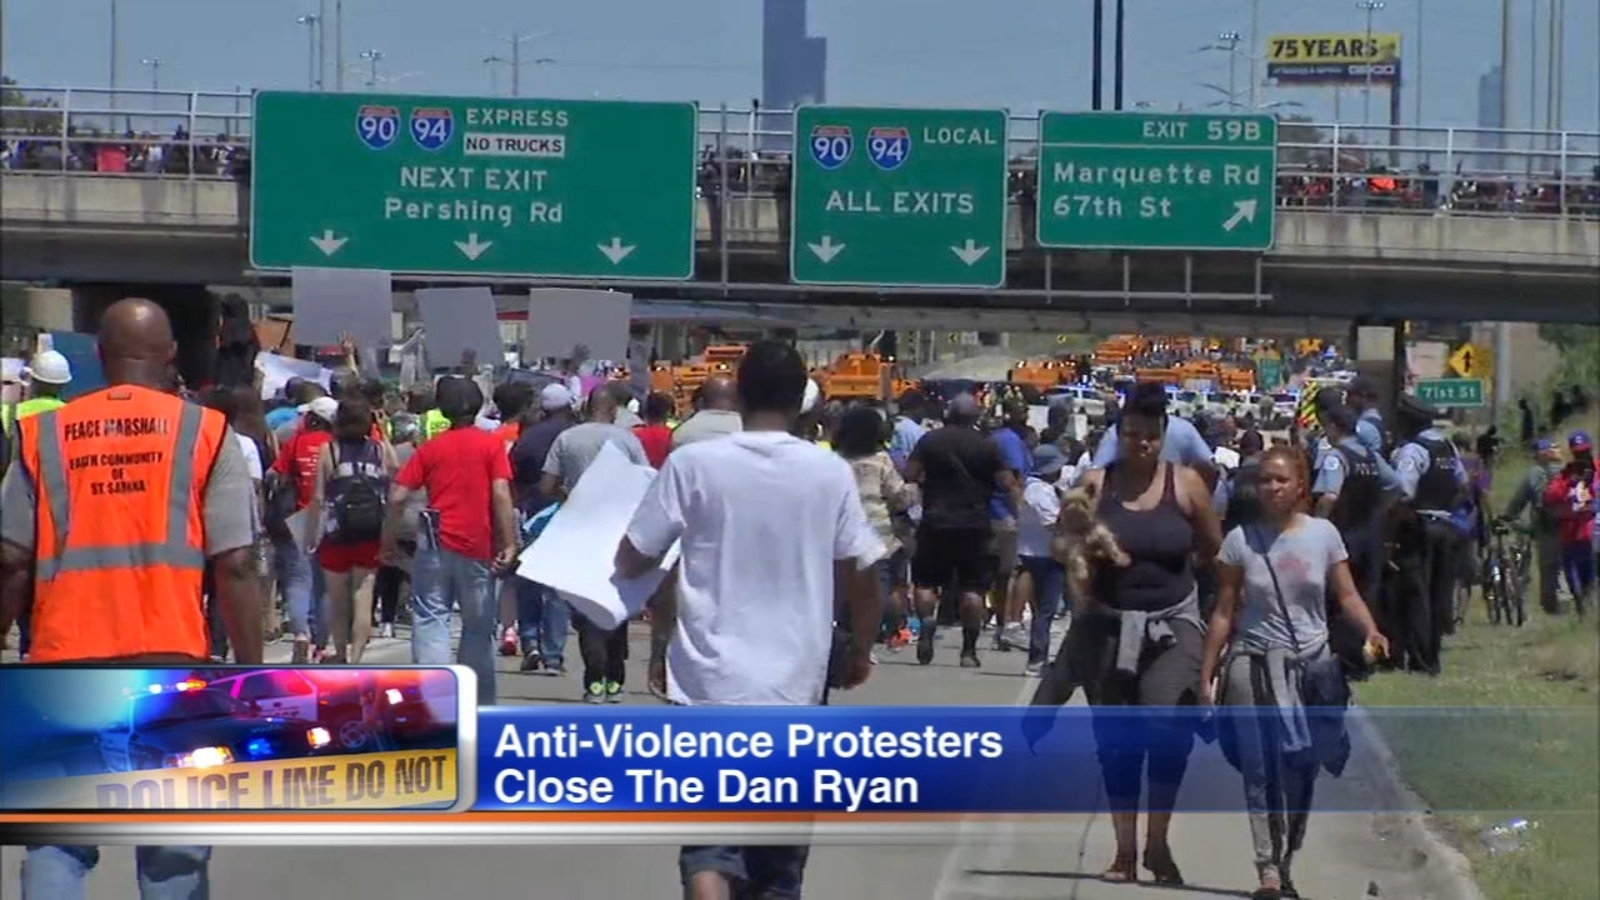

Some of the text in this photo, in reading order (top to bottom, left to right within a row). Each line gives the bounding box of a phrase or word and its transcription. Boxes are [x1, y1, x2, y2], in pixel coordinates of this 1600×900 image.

[1272, 39, 1379, 58] 75 YEARS
[466, 108, 569, 128] EXPRESS
[361, 117, 447, 142] 90 94
[923, 127, 997, 146] LOCAL
[1142, 121, 1261, 141] EXIT 59B
[466, 137, 563, 154] NO TRUCKS
[813, 136, 904, 162] 90 94
[400, 167, 547, 191] NEXT EXIT
[1053, 161, 1260, 186] Marquette Rd
[384, 198, 563, 228] Pershing Rd
[825, 190, 975, 215] ALL EXITS
[1053, 194, 1172, 218] 67th St
[1422, 385, 1476, 400] 71st St
[64, 417, 168, 442] PEACE MARSHALL
[100, 451, 163, 467] COMMUNITY
[111, 468, 124, 481] OF
